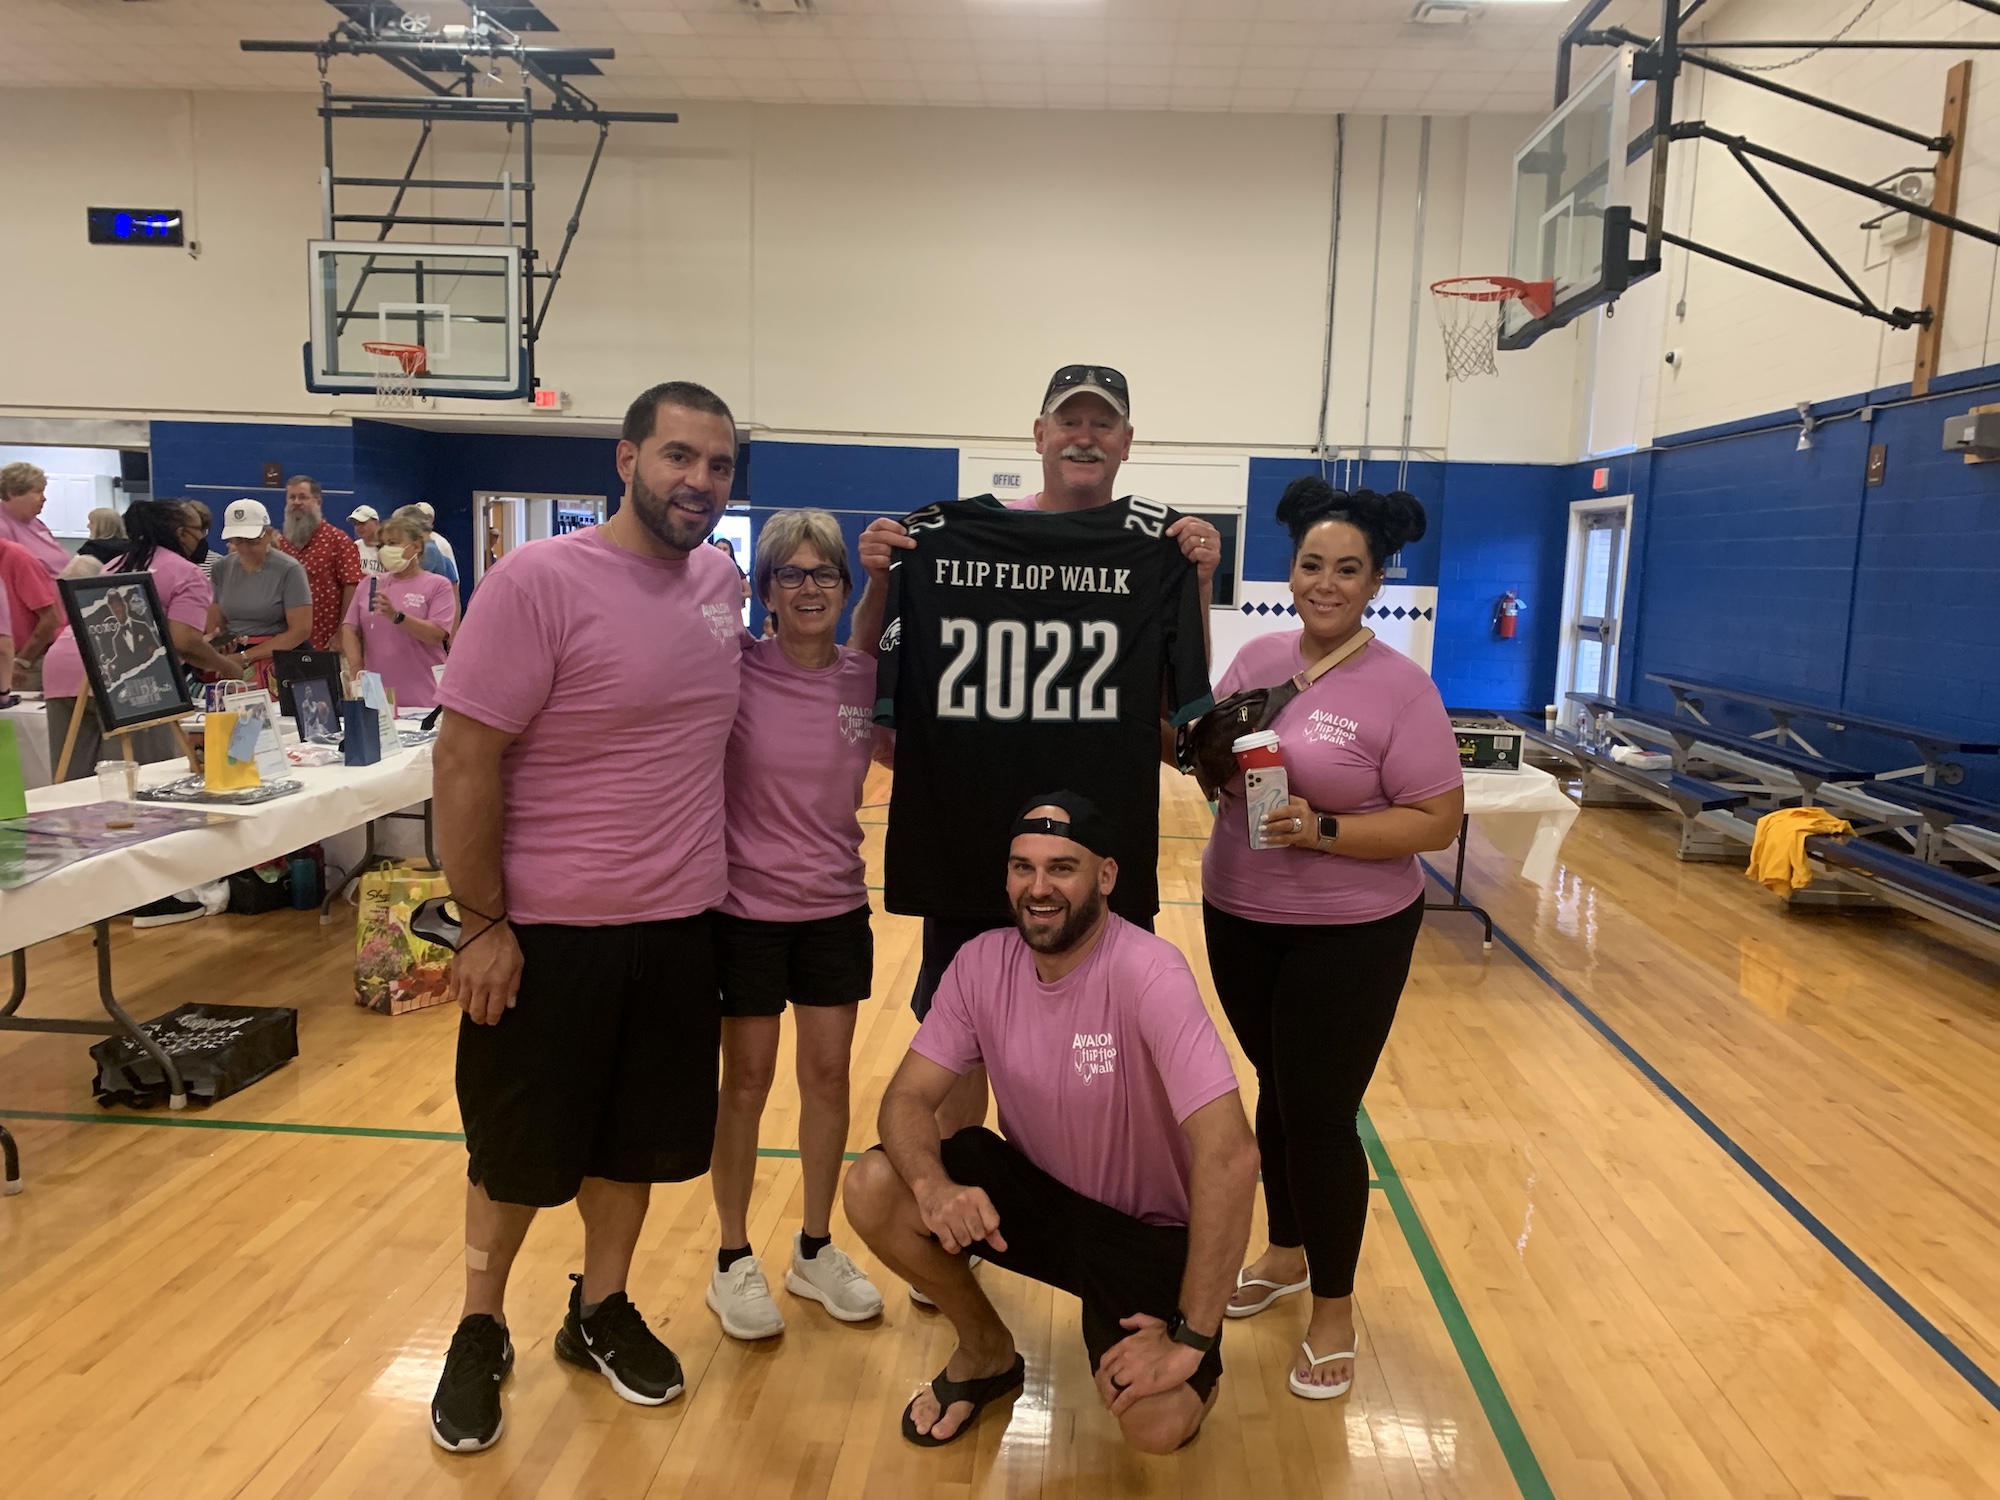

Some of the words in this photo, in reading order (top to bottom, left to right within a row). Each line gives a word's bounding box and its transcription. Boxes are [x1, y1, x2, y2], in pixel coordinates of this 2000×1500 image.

[993, 474, 1021, 487] OFFICE
[1123, 495, 1168, 539] 20
[935, 559, 990, 587] FLIP
[995, 562, 1055, 590] FLOP
[1059, 565, 1131, 594] WALK
[936, 616, 1120, 722] 2022
[1308, 709, 1358, 732] AVALON
[1313, 721, 1334, 733] flip
[1333, 727, 1356, 741] flop
[1072, 1033, 1114, 1049] AVALON
